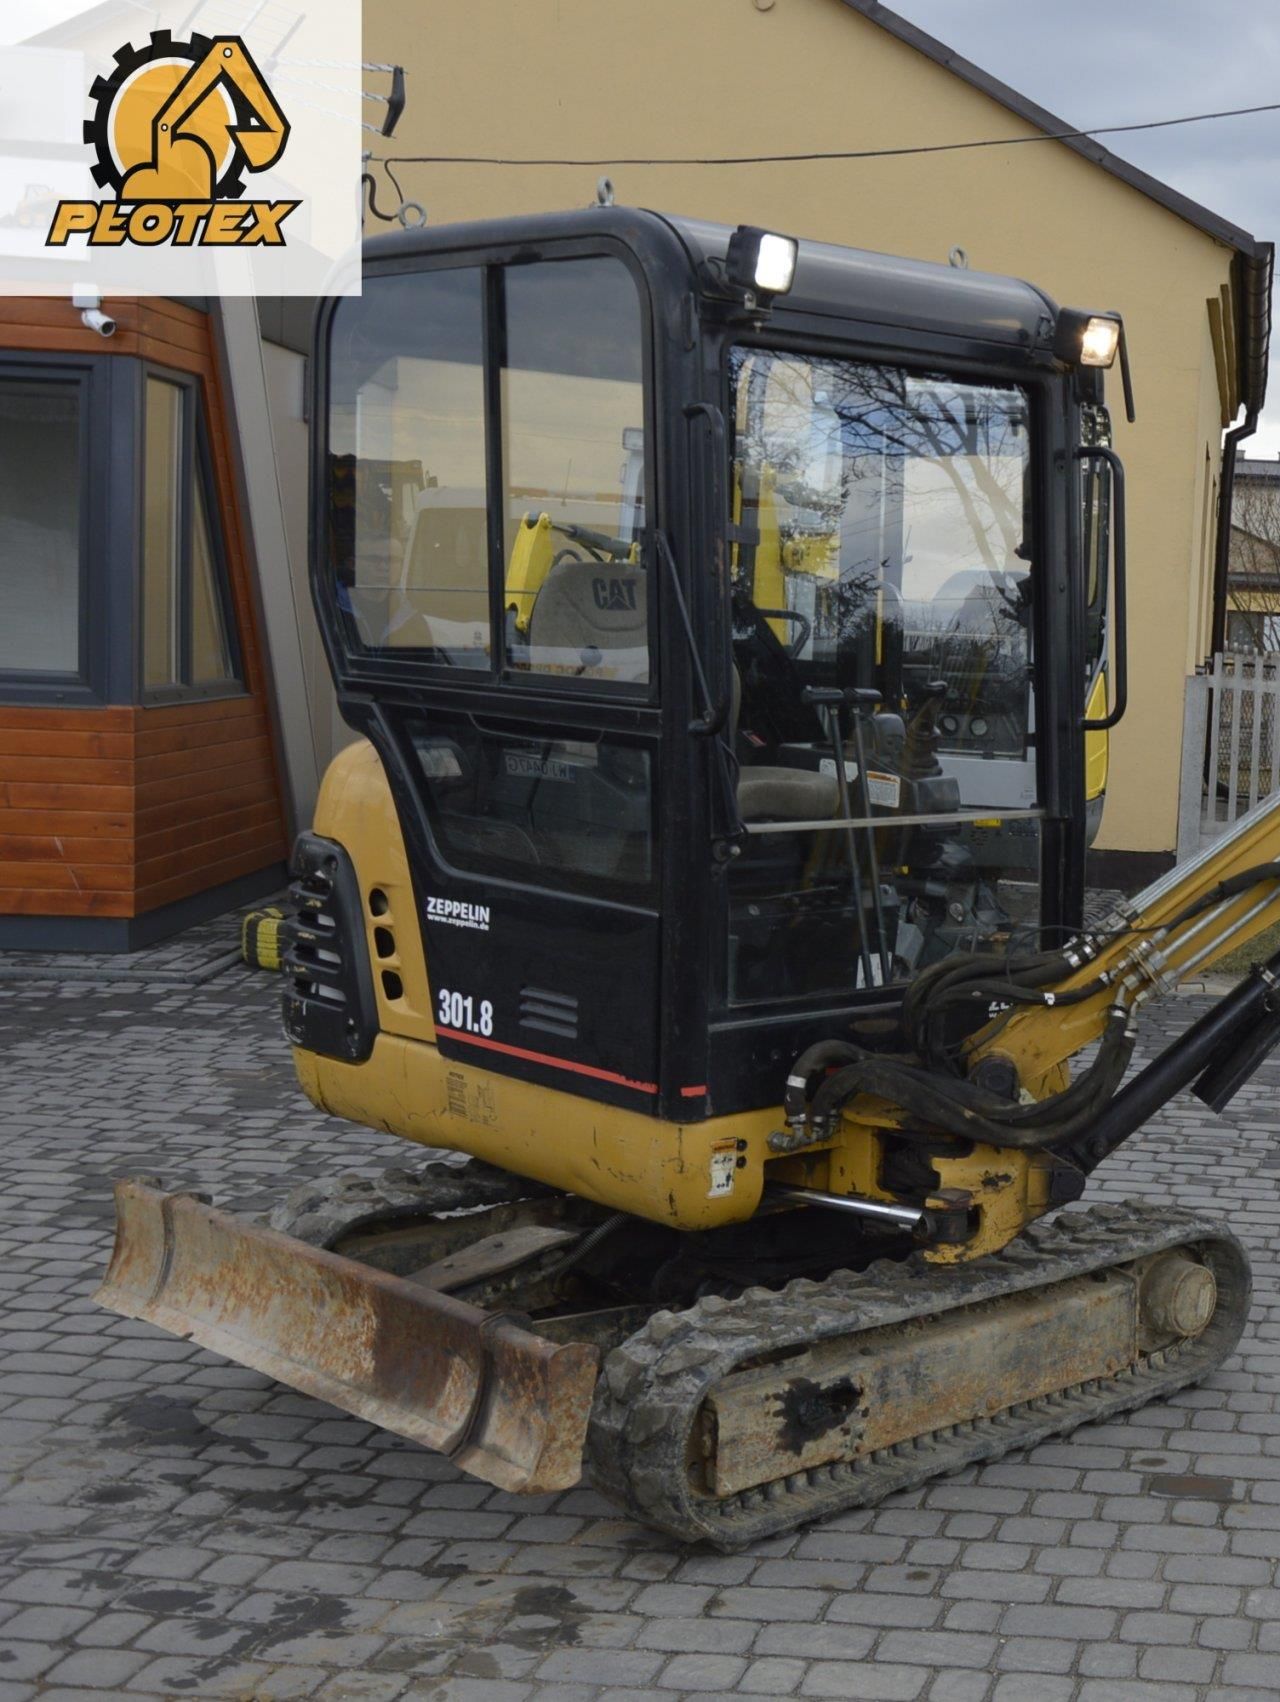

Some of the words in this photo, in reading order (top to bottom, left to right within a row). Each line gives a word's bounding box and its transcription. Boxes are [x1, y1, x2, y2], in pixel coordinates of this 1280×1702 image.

[592, 578, 637, 610] CAT
[427, 896, 490, 923] ZEPPELIN
[439, 988, 493, 1037] 301.8
